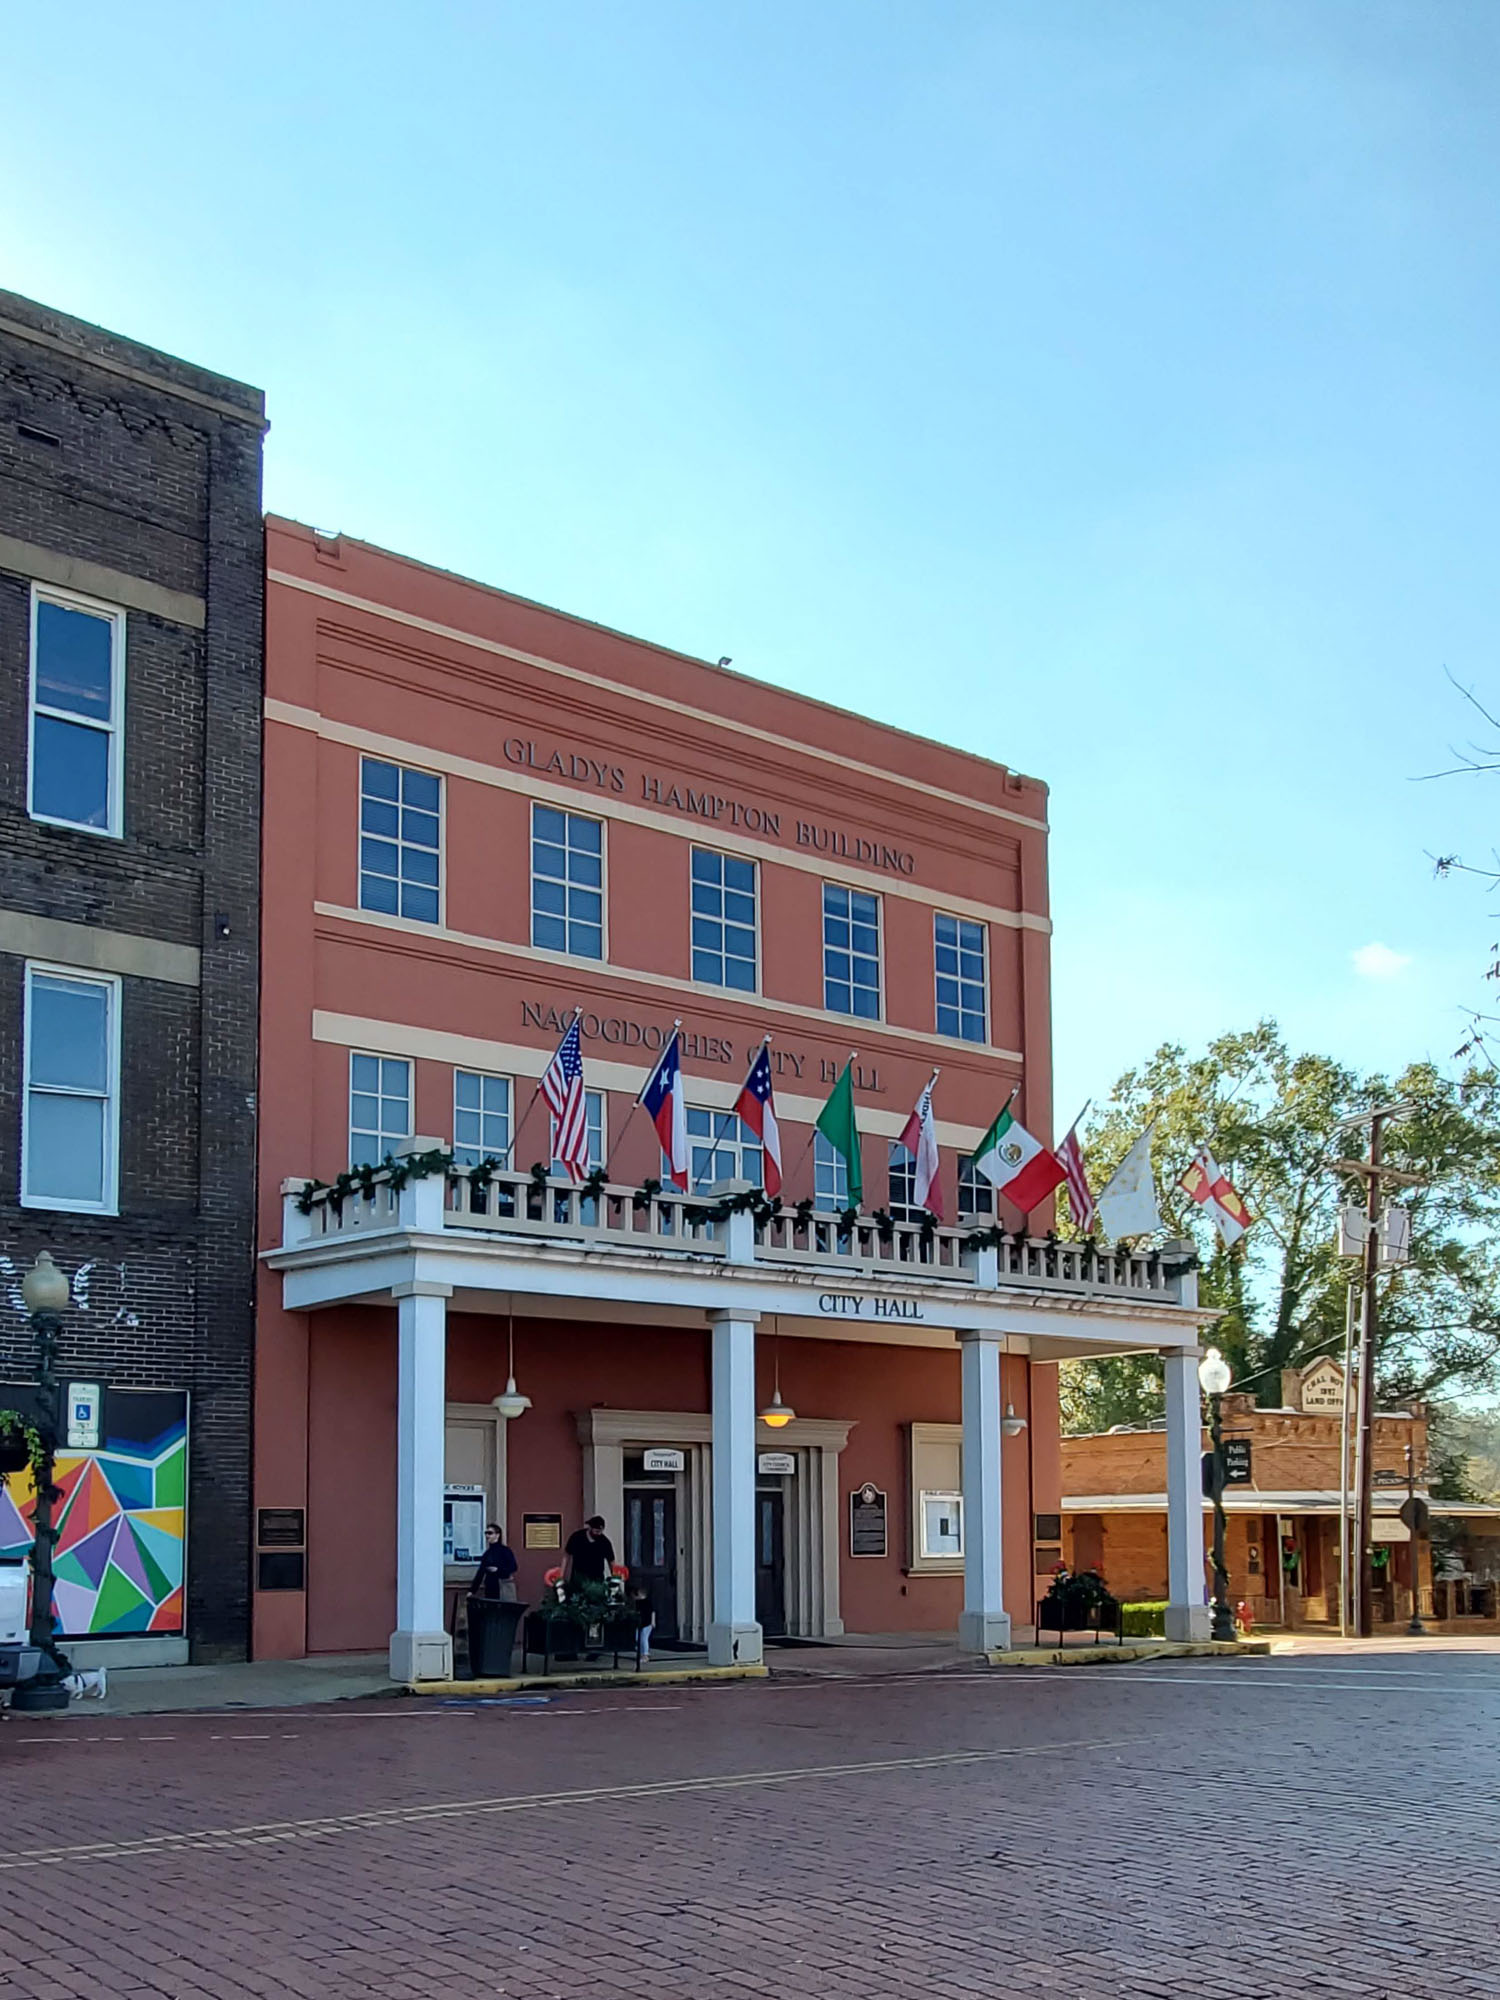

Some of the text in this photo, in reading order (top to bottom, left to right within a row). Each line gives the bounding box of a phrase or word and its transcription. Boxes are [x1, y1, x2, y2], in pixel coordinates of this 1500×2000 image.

[503, 737, 916, 876] GLADYS HAMPTON BUILDING
[747, 1045, 805, 1079] CTY
[821, 1058, 886, 1093] HLL
[819, 1293, 924, 1319] CITY HALL
[1306, 1397, 1325, 1405] LAND
[650, 1460, 678, 1469] CITY HALL
